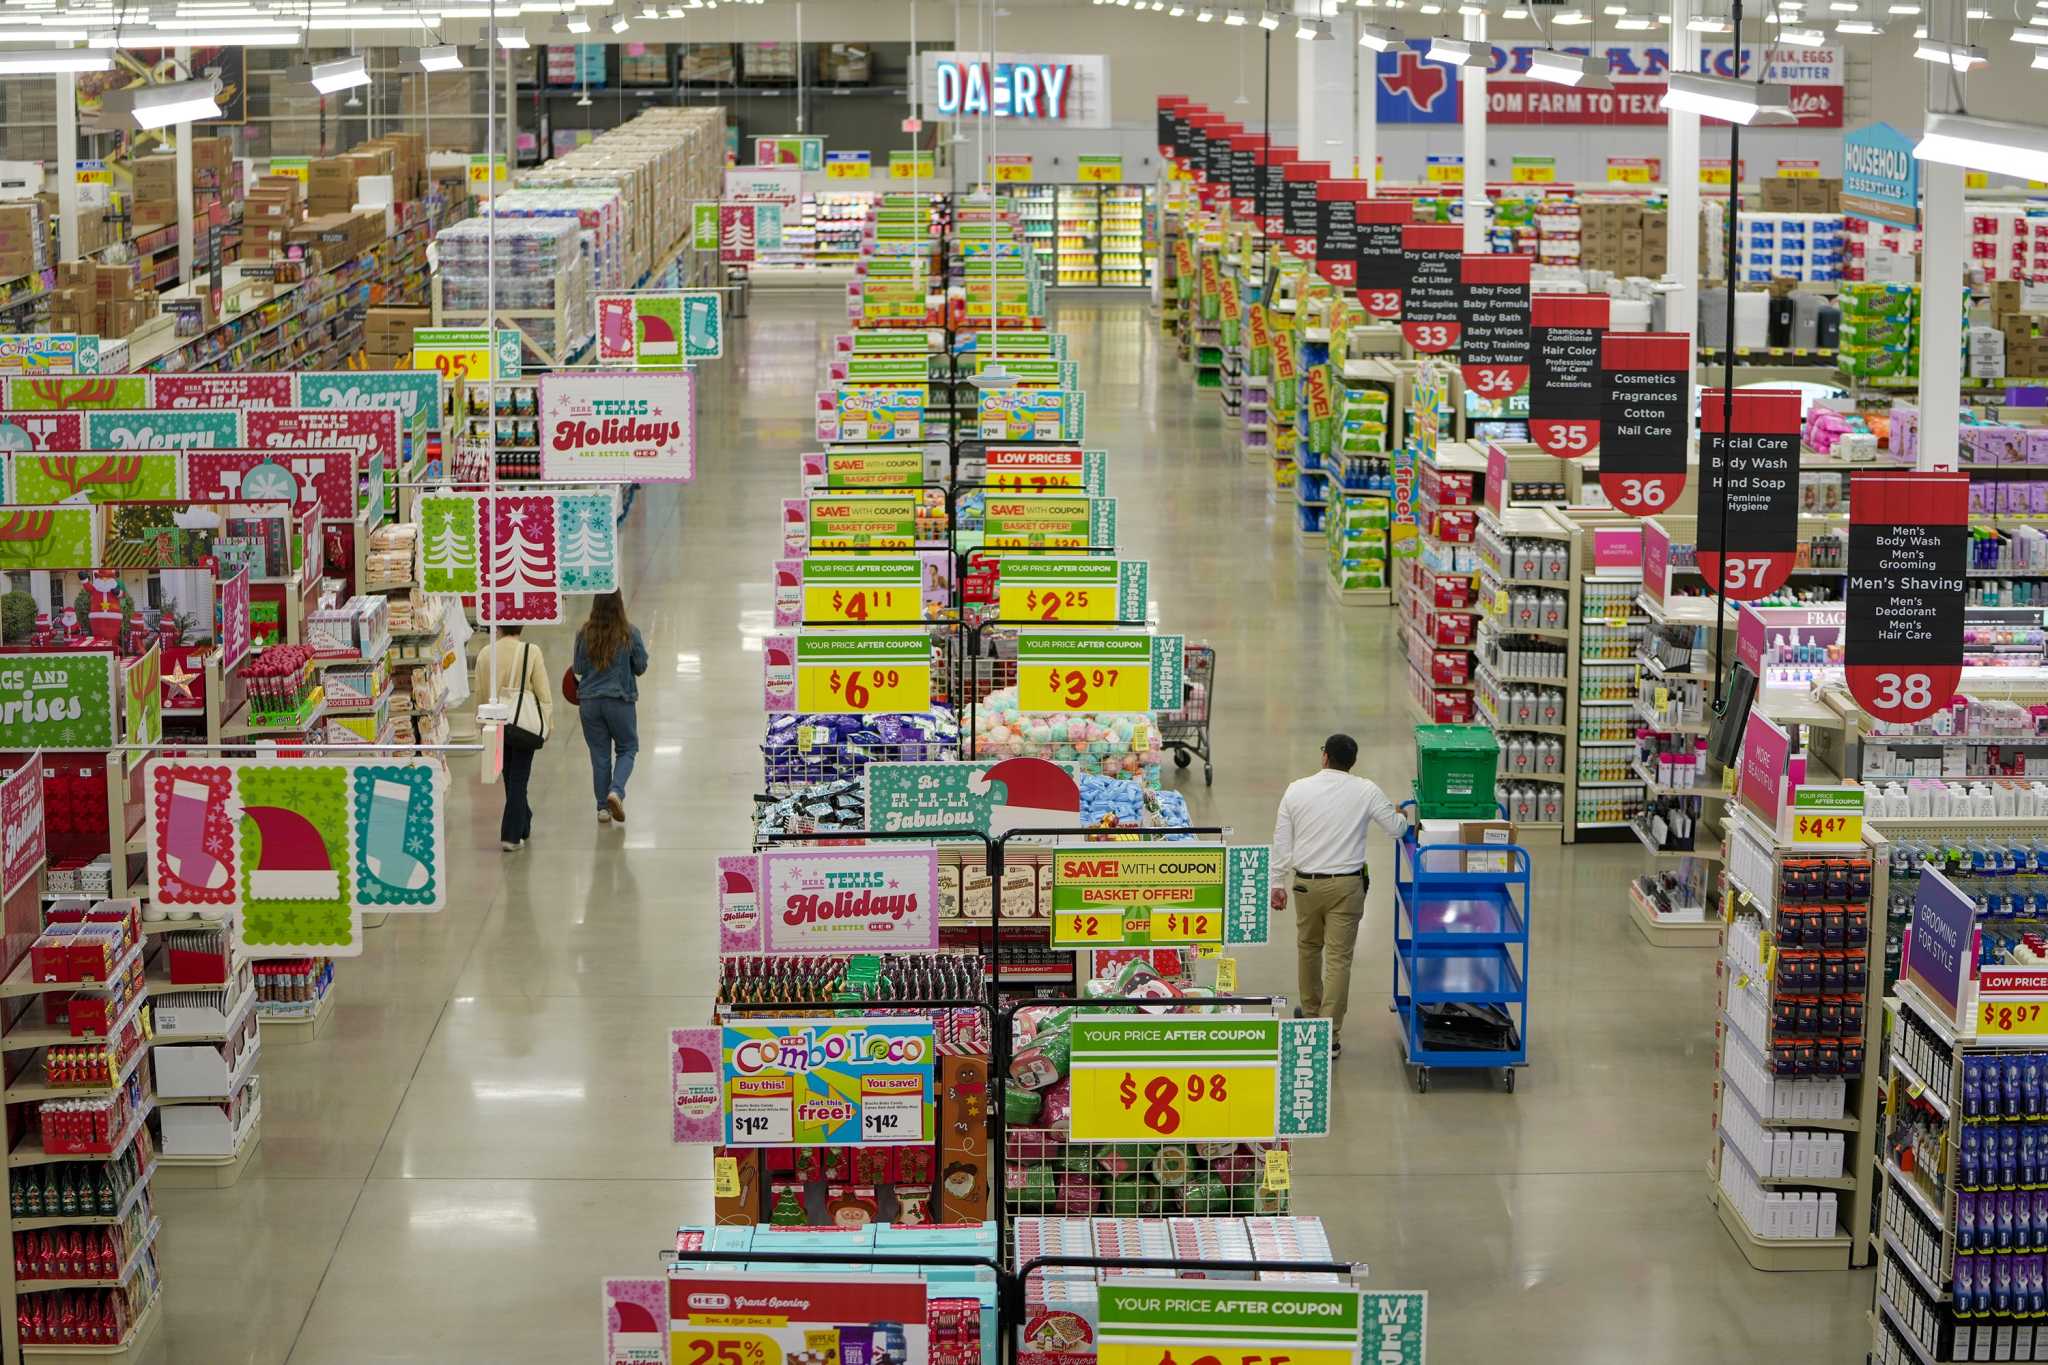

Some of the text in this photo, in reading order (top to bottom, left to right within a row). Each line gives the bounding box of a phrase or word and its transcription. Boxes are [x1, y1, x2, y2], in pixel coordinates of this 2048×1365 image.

[1803, 51, 1833, 63] EGGS
[1768, 67, 1829, 78] & BUTTER
[1528, 94, 1612, 112] FARM TO
[1845, 144, 1907, 181] HOUSEHOLD
[1405, 252, 1420, 260] Dry
[1332, 264, 1352, 280] 31
[1413, 276, 1452, 284] Cat Litter
[1411, 288, 1453, 296] Pet Treats
[1471, 287, 1521, 295] Baby Food
[1371, 294, 1398, 310] 32
[1420, 301, 1458, 309] Supplies
[1464, 301, 1486, 309] Baby
[1407, 313, 1434, 321] Puppy
[1473, 314, 1496, 322] Baby
[1251, 306, 1267, 345] SAVE!
[1416, 326, 1447, 345] 33
[1468, 328, 1523, 336] Baby Wipes
[1464, 341, 1530, 350] Potty Training
[1543, 347, 1596, 355] Hair Color
[1274, 334, 1293, 377] SAVE!
[1469, 355, 1492, 363] Baby
[1478, 370, 1513, 391] 34
[1615, 375, 1675, 383] Cosmetics
[203, 380, 248, 396] TEXAS
[1311, 370, 1329, 416] SAVE!
[1612, 392, 1677, 402] Fragrances
[593, 400, 648, 415] TEXAS
[1624, 409, 1665, 417] Cotton
[299, 415, 348, 429] TEXAS
[553, 418, 680, 450] Holidays
[1618, 426, 1671, 435] Nail Care
[1549, 426, 1587, 449] 35
[1758, 439, 1788, 448] Care
[834, 460, 863, 469] SAVE!
[1029, 455, 1071, 463] PRICES
[1752, 458, 1787, 468] Wash
[1752, 478, 1785, 489] Soap
[1396, 467, 1415, 523] free!
[1621, 480, 1665, 506] 36
[1727, 494, 1771, 502] Feminine
[817, 507, 849, 516] SAVE!
[992, 505, 1024, 515] SAVE!
[1729, 503, 1768, 511] Hygiene
[1893, 527, 1925, 535] Men's
[1877, 537, 1940, 546] Body Wash
[1892, 550, 1924, 559] Men's
[1880, 560, 1936, 570] Grooming
[1725, 559, 1771, 589] 37
[1851, 578, 1963, 591] Men's Shaving
[1891, 597, 1922, 605] Men's
[1876, 607, 1936, 616] Deodorant
[1890, 621, 1921, 629] Men's
[1879, 631, 1932, 639] Hair Care
[32, 670, 68, 683] AND
[1159, 639, 1175, 708] MERRY
[1873, 674, 1931, 709] 38
[1756, 744, 1770, 769] MORE
[919, 776, 940, 789] Be
[1749, 760, 1774, 794] BEAUTIFUL
[885, 809, 975, 832] Fabulous
[1064, 861, 1216, 877] SAVE! WITH COUPON
[825, 872, 883, 888] TEXAS
[1084, 888, 1193, 900] BASKET OFFER!
[1240, 850, 1258, 941] MERRY
[783, 890, 917, 925] Holidays
[723, 911, 757, 921] Holidays
[1126, 920, 1150, 930] OFF
[1921, 904, 1957, 949] GROOMING
[1918, 928, 1953, 973] FOR STYLE
[1987, 978, 2013, 987] LOW
[1084, 1030, 1265, 1041] YOUR PRICE AFTER COUPON
[736, 1029, 921, 1073] Combo Loco
[867, 1079, 918, 1087] You save!
[1292, 1025, 1316, 1131] MERRY
[740, 1081, 784, 1090] Buy this!
[678, 1095, 717, 1105] Holidays
[799, 1104, 852, 1120] free!
[735, 1297, 810, 1310] Grand Opening
[1115, 1298, 1342, 1315] YOUR PRICE AFTER COUPON
